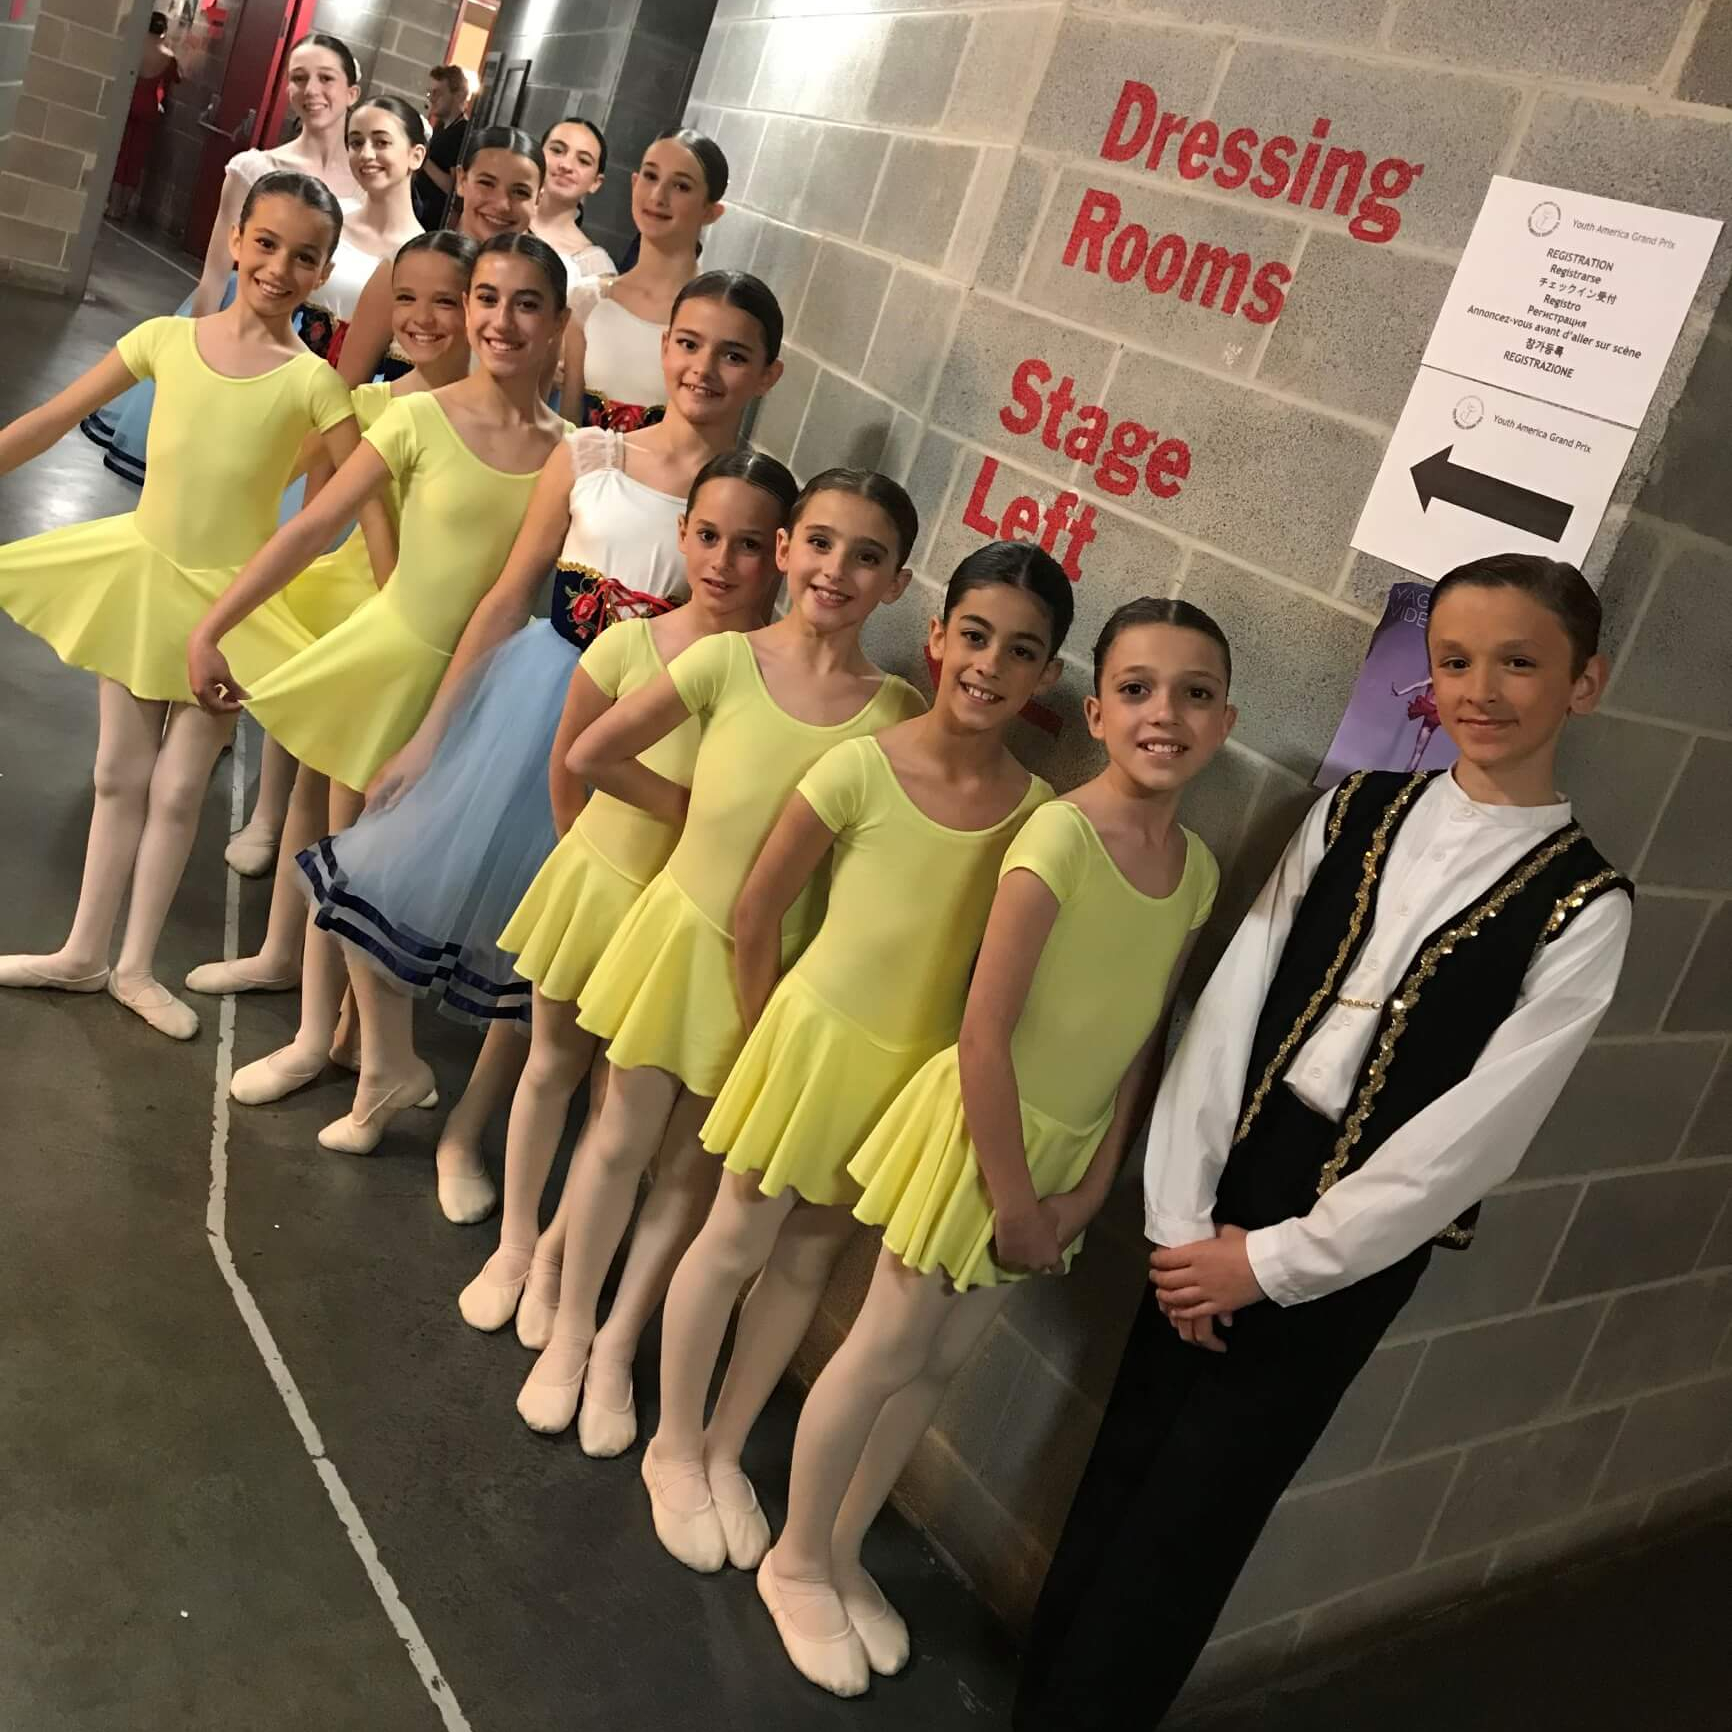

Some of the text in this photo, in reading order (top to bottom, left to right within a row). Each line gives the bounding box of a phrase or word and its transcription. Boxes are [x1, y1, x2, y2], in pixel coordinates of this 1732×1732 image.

[1100, 79, 1425, 244] Dressing
[1573, 219, 1676, 250] Youth America Grand Prix
[1062, 187, 1293, 325] Rooms
[1546, 248, 1614, 272] REGISTRATION
[1550, 264, 1602, 284] Registrarse
[1539, 277, 1617, 305] チェックイン受付
[1543, 294, 1582, 312] Registro
[1527, 304, 1588, 329] Регистрация
[1467, 304, 1642, 360] Annoncez-vous avant d'aller sur scène
[1526, 337, 1564, 358] 참가등록
[1503, 350, 1575, 379] REGISTRAZIONE
[1000, 358, 1193, 499] Stage
[1493, 414, 1592, 454] Youth America Grand Prix
[962, 455, 1098, 583] Left
